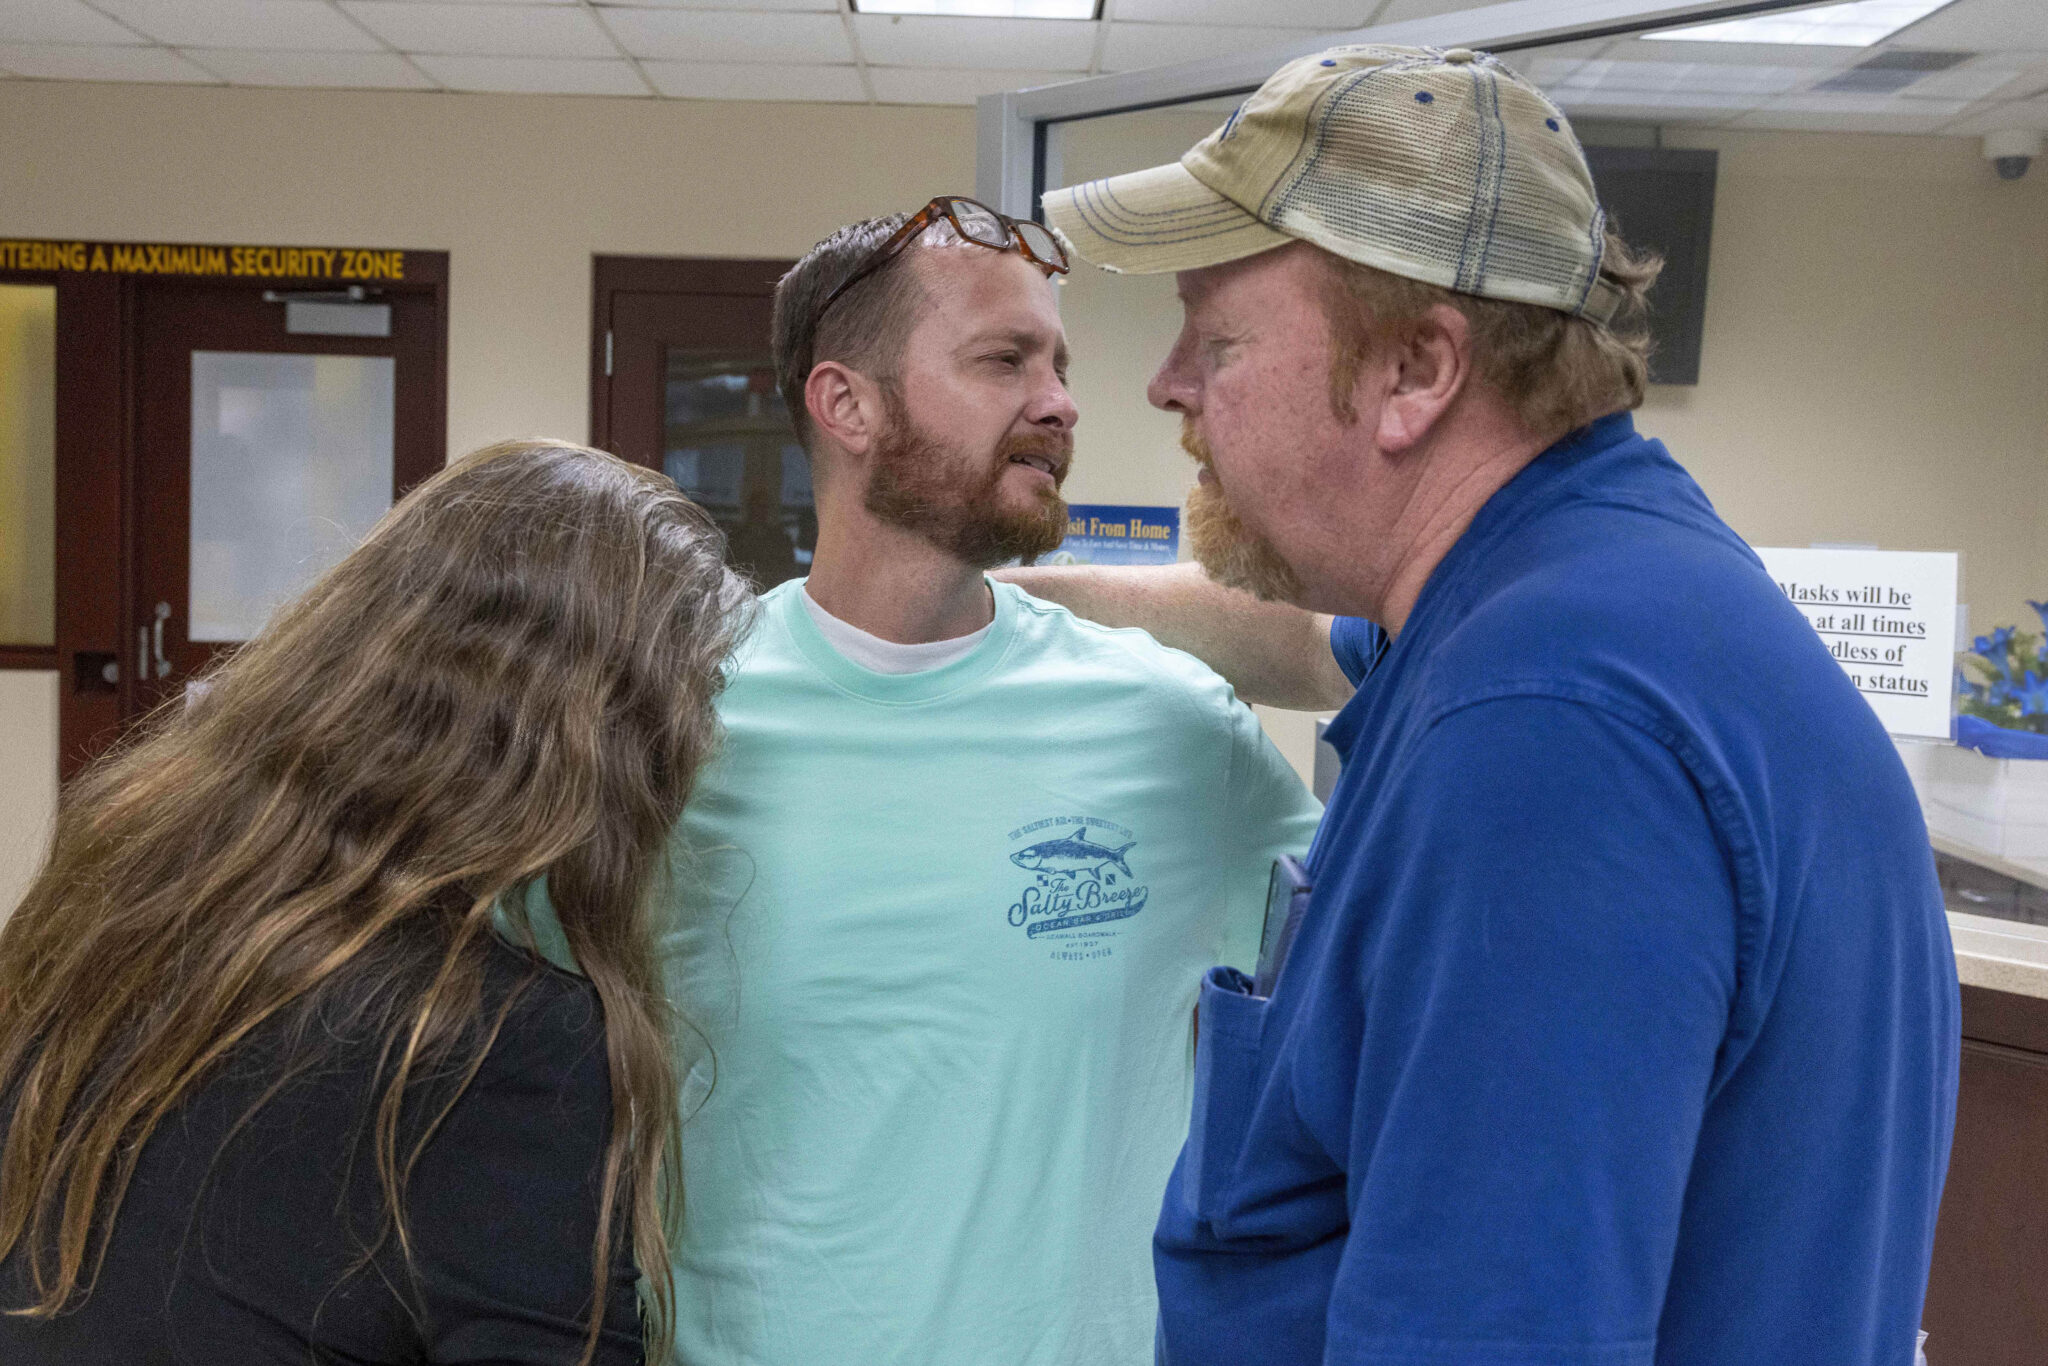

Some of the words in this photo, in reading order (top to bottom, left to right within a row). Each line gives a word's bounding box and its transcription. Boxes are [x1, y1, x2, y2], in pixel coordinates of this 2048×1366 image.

[0, 241, 87, 272] TERING
[89, 245, 110, 272] A
[112, 244, 227, 276] MAXIMUM
[231, 247, 338, 277] SECURITY
[341, 250, 404, 279] ZONE
[1066, 517, 1086, 535] isit
[1090, 517, 1126, 538] From
[1130, 519, 1171, 540] Home
[1780, 582, 1840, 602] Masks
[1846, 586, 1881, 604] will
[1889, 587, 1912, 606] be
[1817, 614, 1836, 630] at
[1841, 614, 1865, 632] all
[1872, 615, 1926, 635] times
[1885, 644, 1907, 662] of
[1869, 674, 1928, 693] status
[1050, 878, 1070, 893] The
[1007, 886, 1078, 927] Salty
[1075, 879, 1147, 914] Breeze
[1035, 919, 1069, 931] OCEAN
